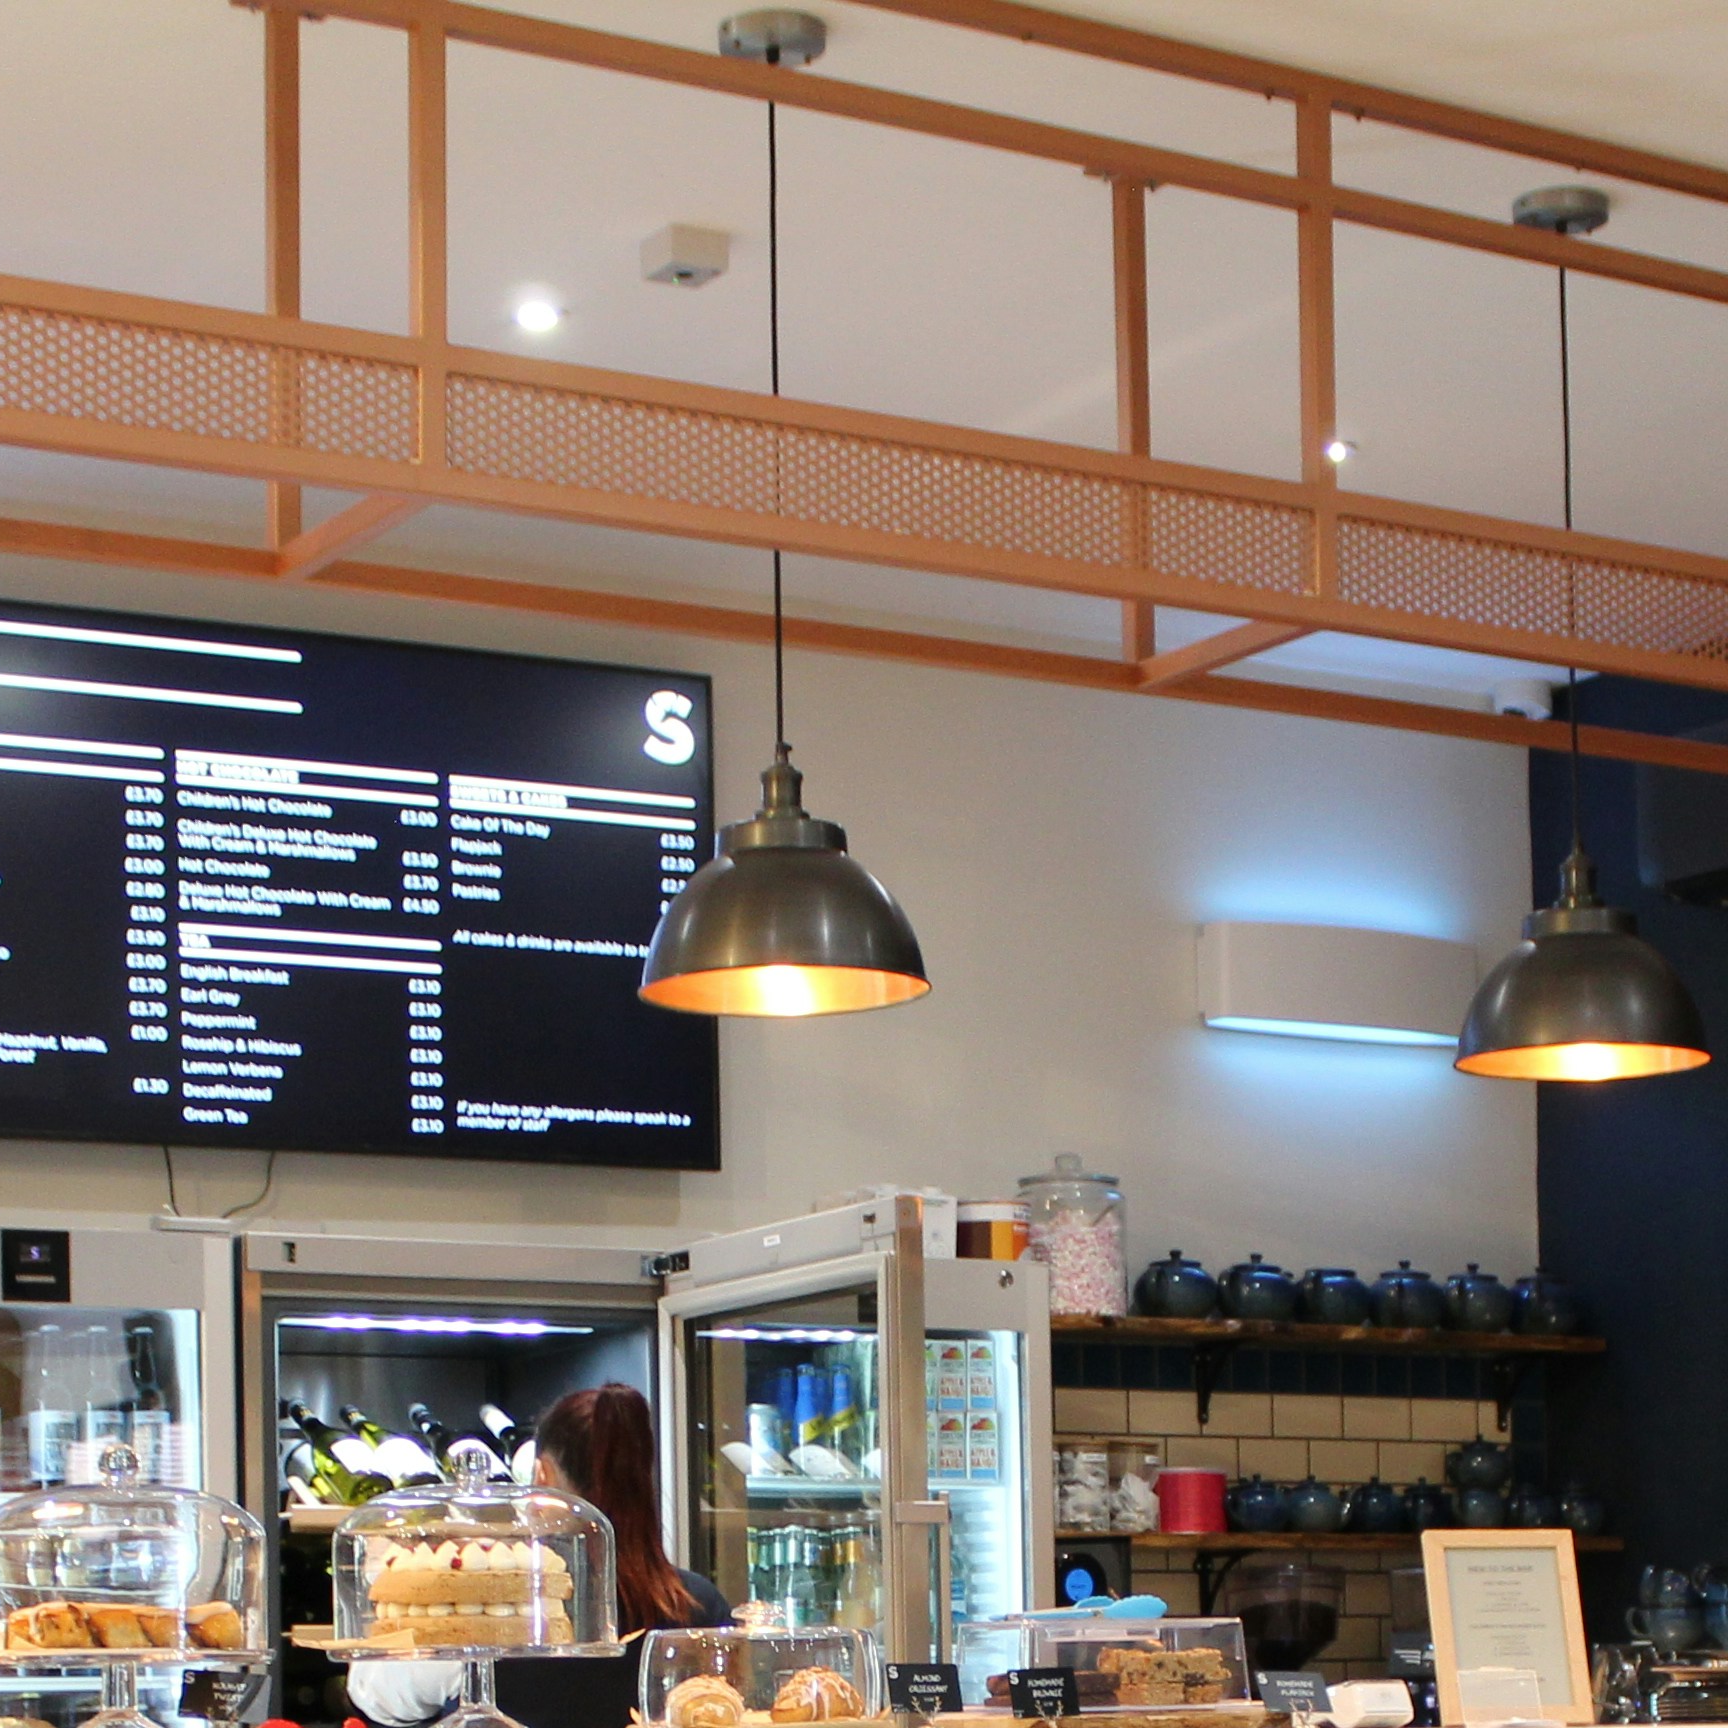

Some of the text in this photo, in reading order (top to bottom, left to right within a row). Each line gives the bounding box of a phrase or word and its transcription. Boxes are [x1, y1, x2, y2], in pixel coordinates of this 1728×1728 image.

[643, 690, 695, 766] S
[176, 760, 300, 785] HOT CHOCOLATE
[125, 785, 164, 804] £3.70
[449, 785, 568, 808] SWEETS & CAKES
[176, 790, 333, 819] Children's Hot Chocolate
[125, 809, 164, 828] £3.70
[400, 809, 439, 828] £3.00
[450, 813, 551, 839] Cake Of The Day
[125, 833, 165, 852] £3.70
[177, 818, 378, 850] Children's Deluxe Hot Chocolate
[660, 833, 695, 851] £3.50
[178, 833, 357, 862] With Cream & Marshmallows
[450, 836, 503, 856] Flapjack
[124, 856, 165, 875] £3.00
[178, 856, 271, 879] Hot Chocolate
[451, 859, 502, 879] Brownie
[403, 874, 439, 892] £3.70
[451, 882, 501, 901] Pastries
[660, 878, 687, 894] £2.5
[178, 879, 392, 911] Deluxe Hot Chocolate With Cream
[179, 895, 282, 917] & Marshmallows
[179, 932, 212, 949] TEA
[452, 929, 470, 945] All
[471, 930, 505, 947] cakes
[505, 932, 516, 948] &
[516, 934, 553, 951] drinks
[553, 938, 573, 952] are
[573, 939, 623, 956] available
[624, 943, 638, 957] to
[126, 952, 167, 970] £3.00
[180, 963, 290, 985] English Breakfast
[128, 976, 167, 994] £3.70
[408, 978, 442, 995] £3.10
[180, 986, 240, 1007] Earl Grey
[128, 1000, 168, 1018] £3.70
[409, 1001, 442, 1018] £3.10
[181, 1010, 257, 1031] Peppermint
[409, 1024, 443, 1041] £3.10
[181, 1034, 302, 1057] Rosehip & Hibiscus
[410, 1048, 443, 1065] £3.10
[182, 1058, 284, 1079] Lemon Verbena
[410, 1071, 443, 1088] £3.10
[182, 1082, 273, 1102] Decaffeinated
[411, 1094, 444, 1111] £3.10
[183, 1106, 249, 1124] Green Tea
[456, 1100, 691, 1127] If you have any allergens please speak to a
[411, 1117, 444, 1134] £3.10
[456, 1115, 550, 1132] member of staff
[913, 1673, 942, 1683] ALMOND
